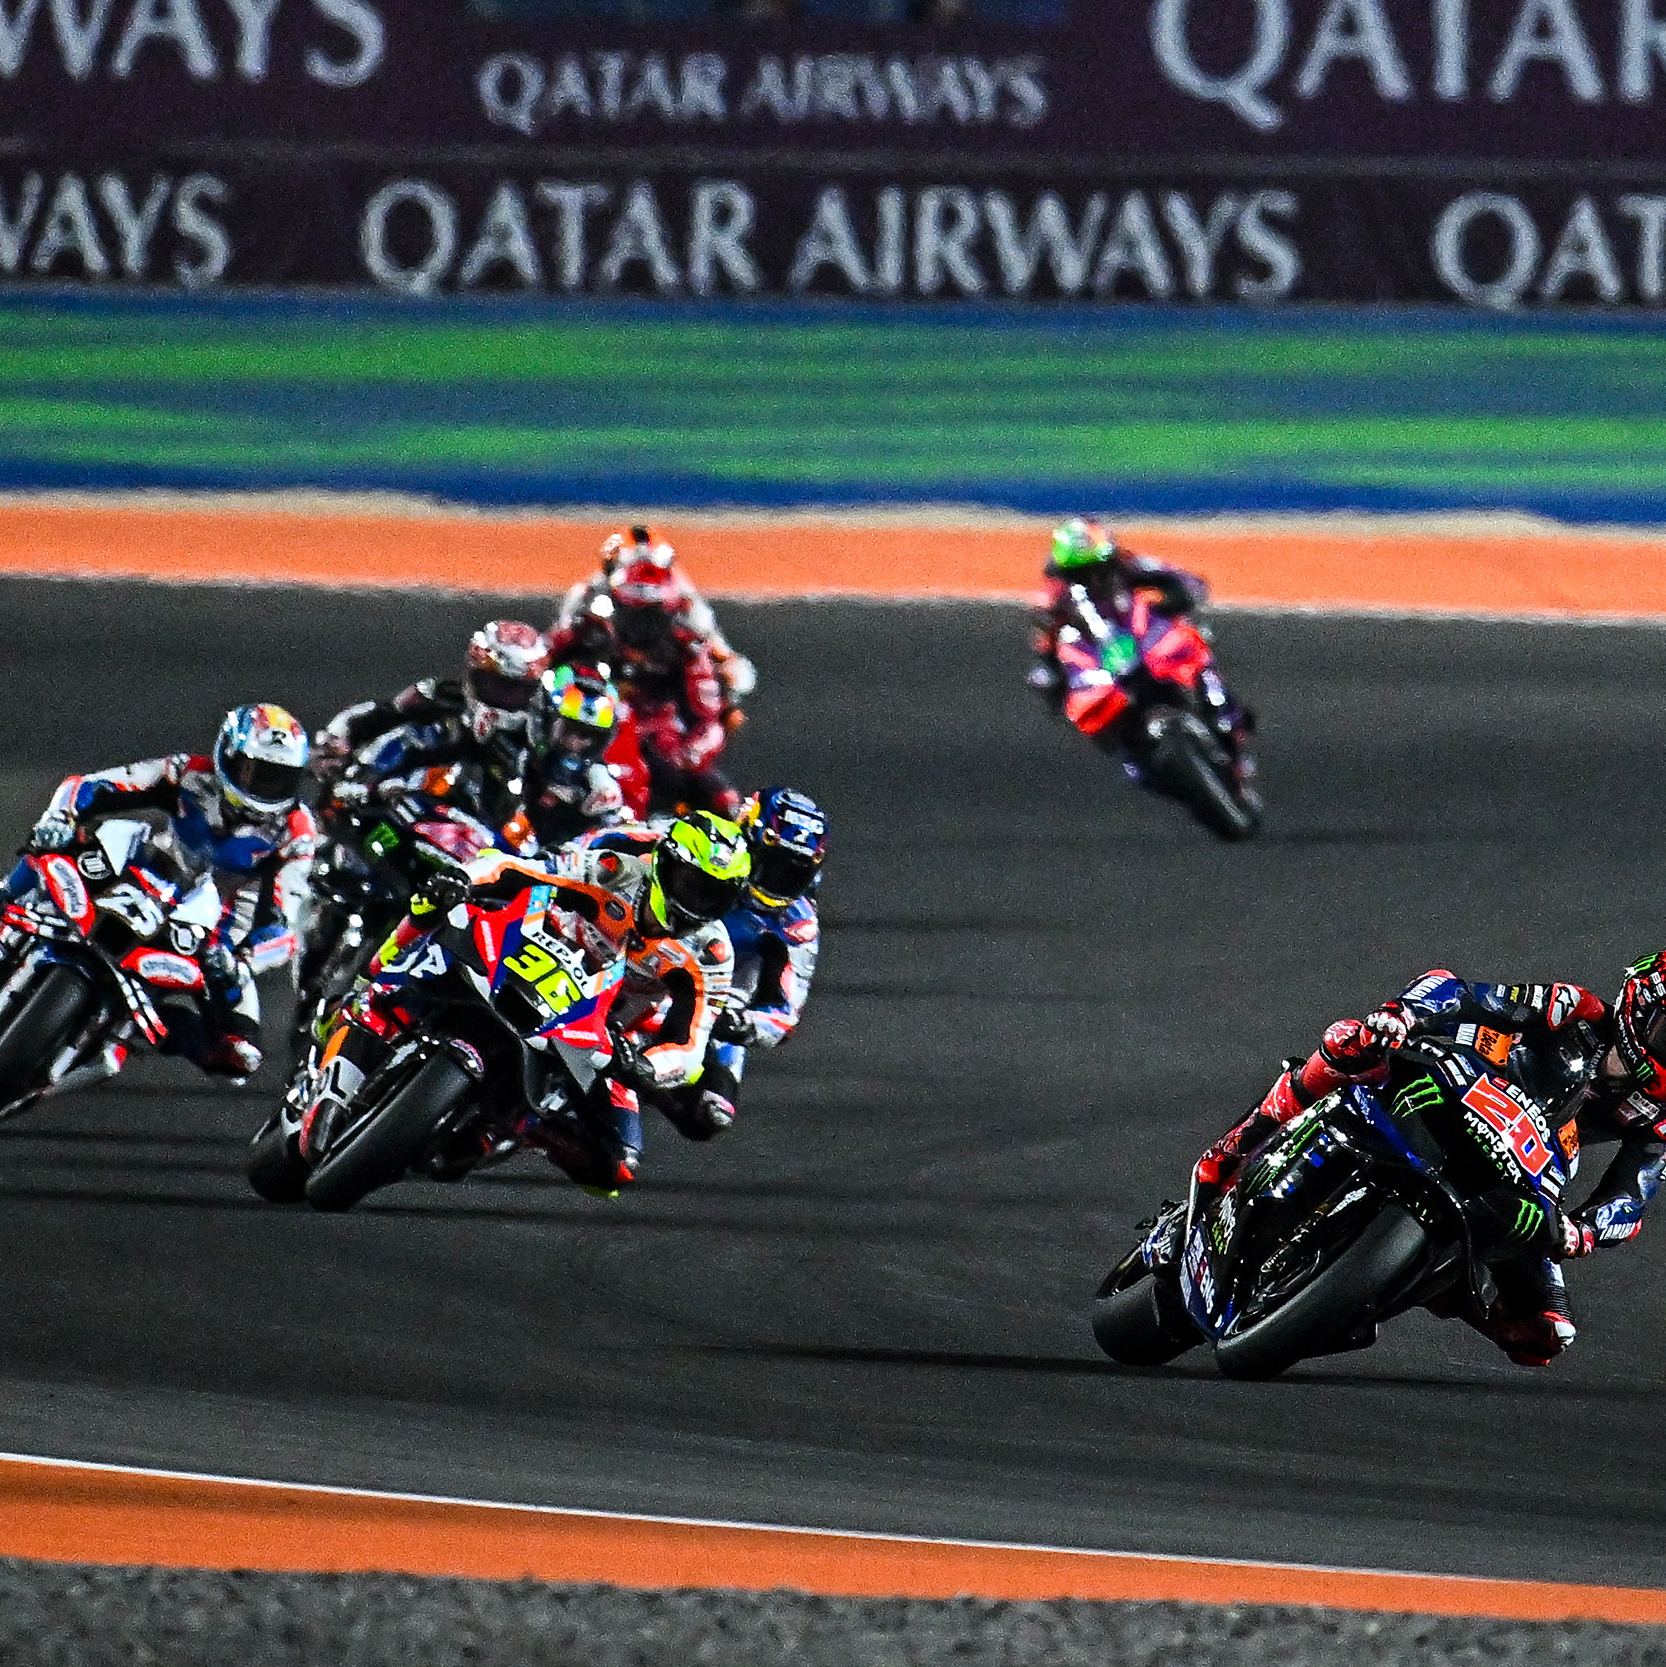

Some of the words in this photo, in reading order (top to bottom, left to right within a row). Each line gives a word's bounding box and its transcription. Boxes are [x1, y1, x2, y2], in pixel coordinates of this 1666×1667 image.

[475, 52, 729, 134] QATAR
[743, 54, 1049, 129] AIRWAYS
[359, 179, 759, 294] QATAR
[792, 187, 1301, 299] AIRWAYS
[503, 943, 582, 1014] 36
[1460, 1072, 1554, 1177] 20
[1464, 1111, 1522, 1184] MONSTER
[1506, 1084, 1551, 1143] ENEOS
